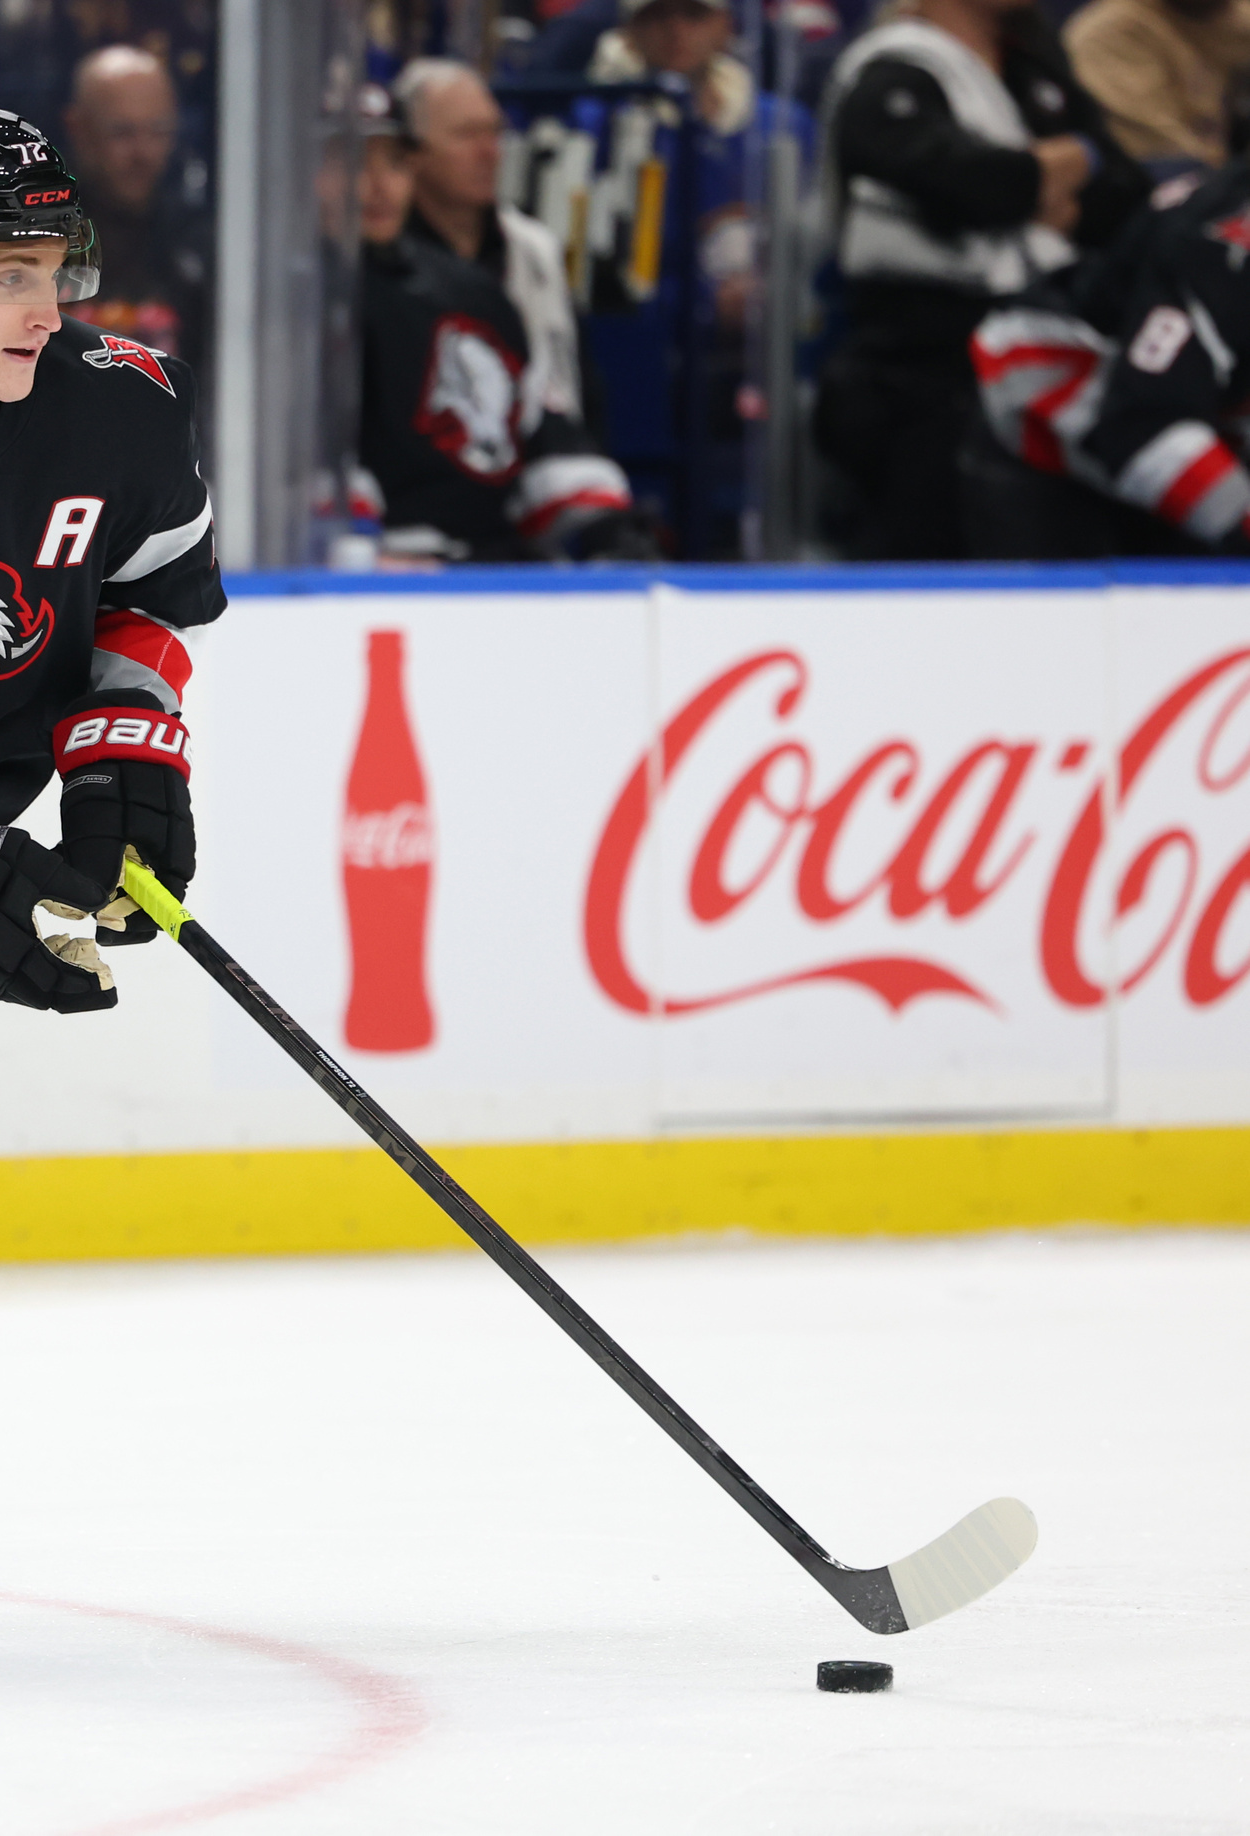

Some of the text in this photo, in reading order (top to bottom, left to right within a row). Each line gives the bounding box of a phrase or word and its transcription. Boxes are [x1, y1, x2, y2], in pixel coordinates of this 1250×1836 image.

[11, 142, 48, 165] 72
[24, 189, 71, 206] CCM
[33, 495, 106, 568] A
[316, 1050, 356, 1088] THOMPSON 72
